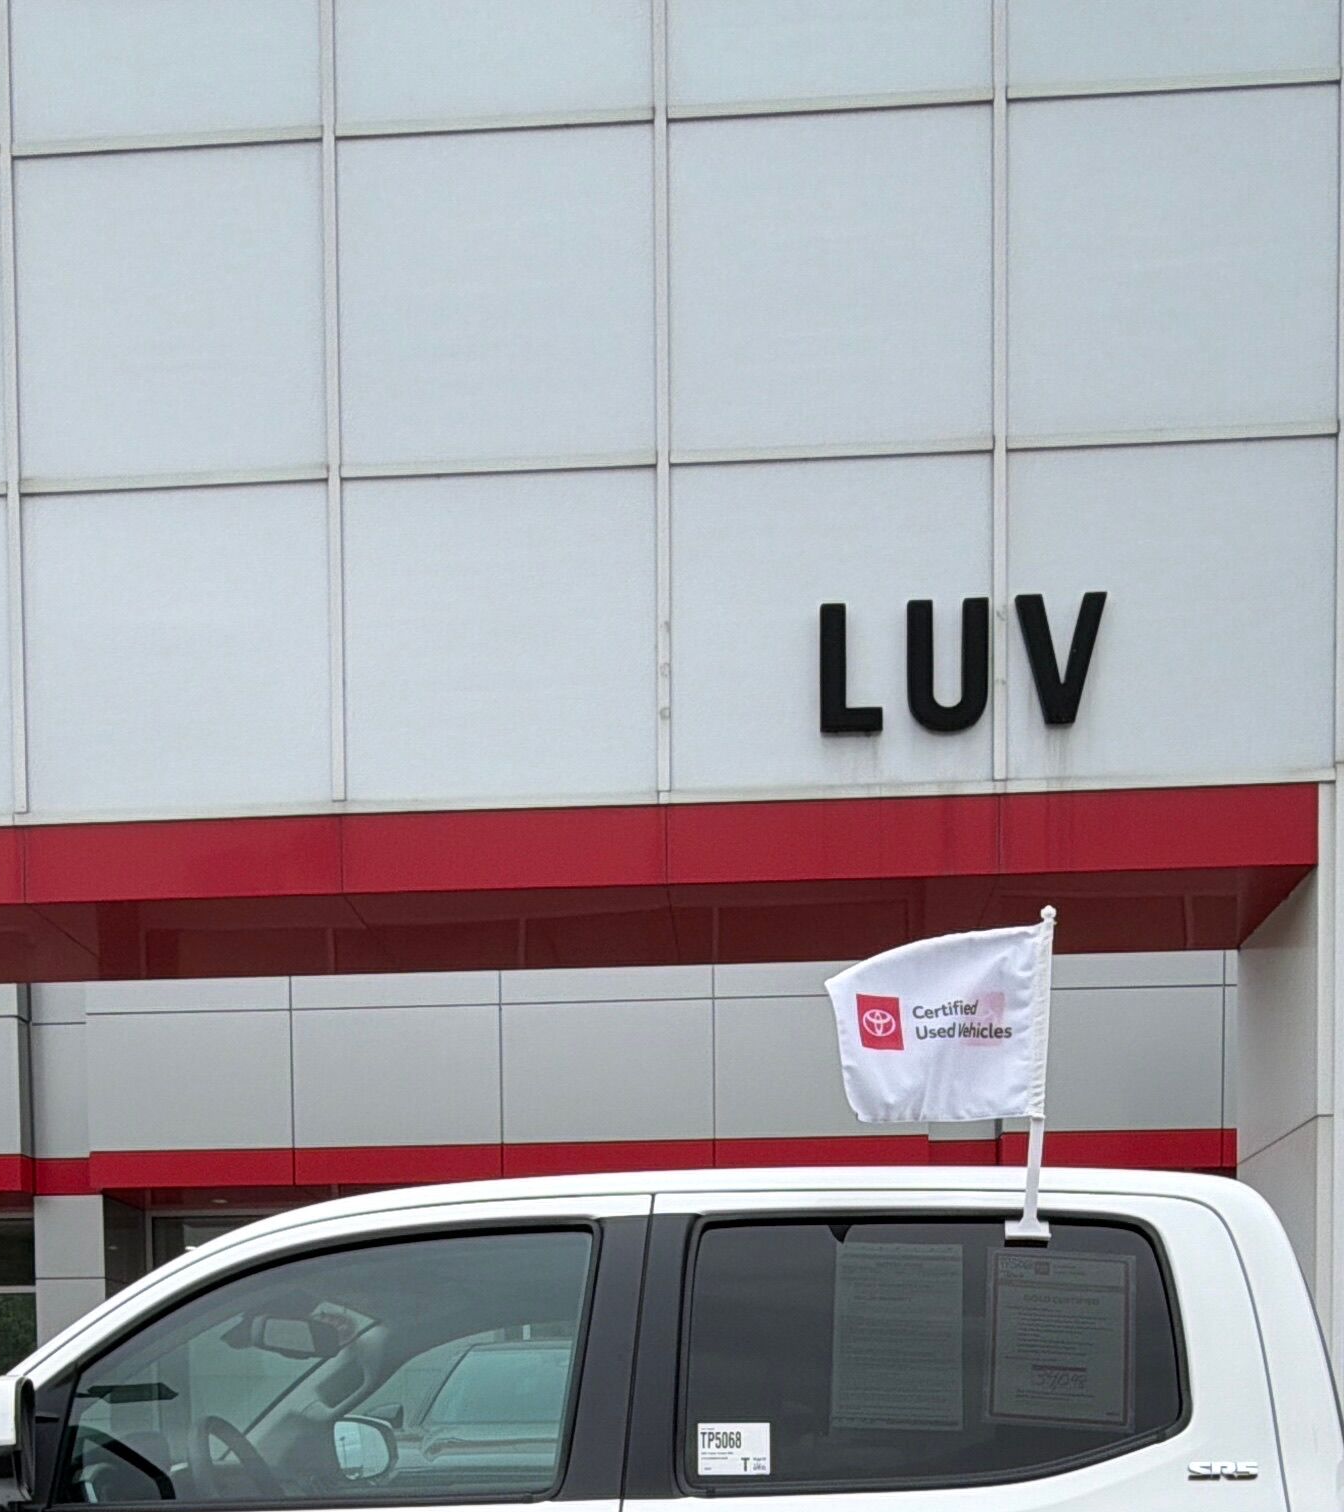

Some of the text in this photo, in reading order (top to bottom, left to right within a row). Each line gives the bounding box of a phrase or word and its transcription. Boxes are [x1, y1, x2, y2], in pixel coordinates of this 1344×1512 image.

[819, 591, 1108, 733] LUV
[911, 999, 979, 1021] Certified
[915, 1022, 1013, 1041] Used Vehicles
[700, 1430, 742, 1449] TP5068
[740, 1456, 751, 1473] T
[1188, 1461, 1259, 1481] SR5
